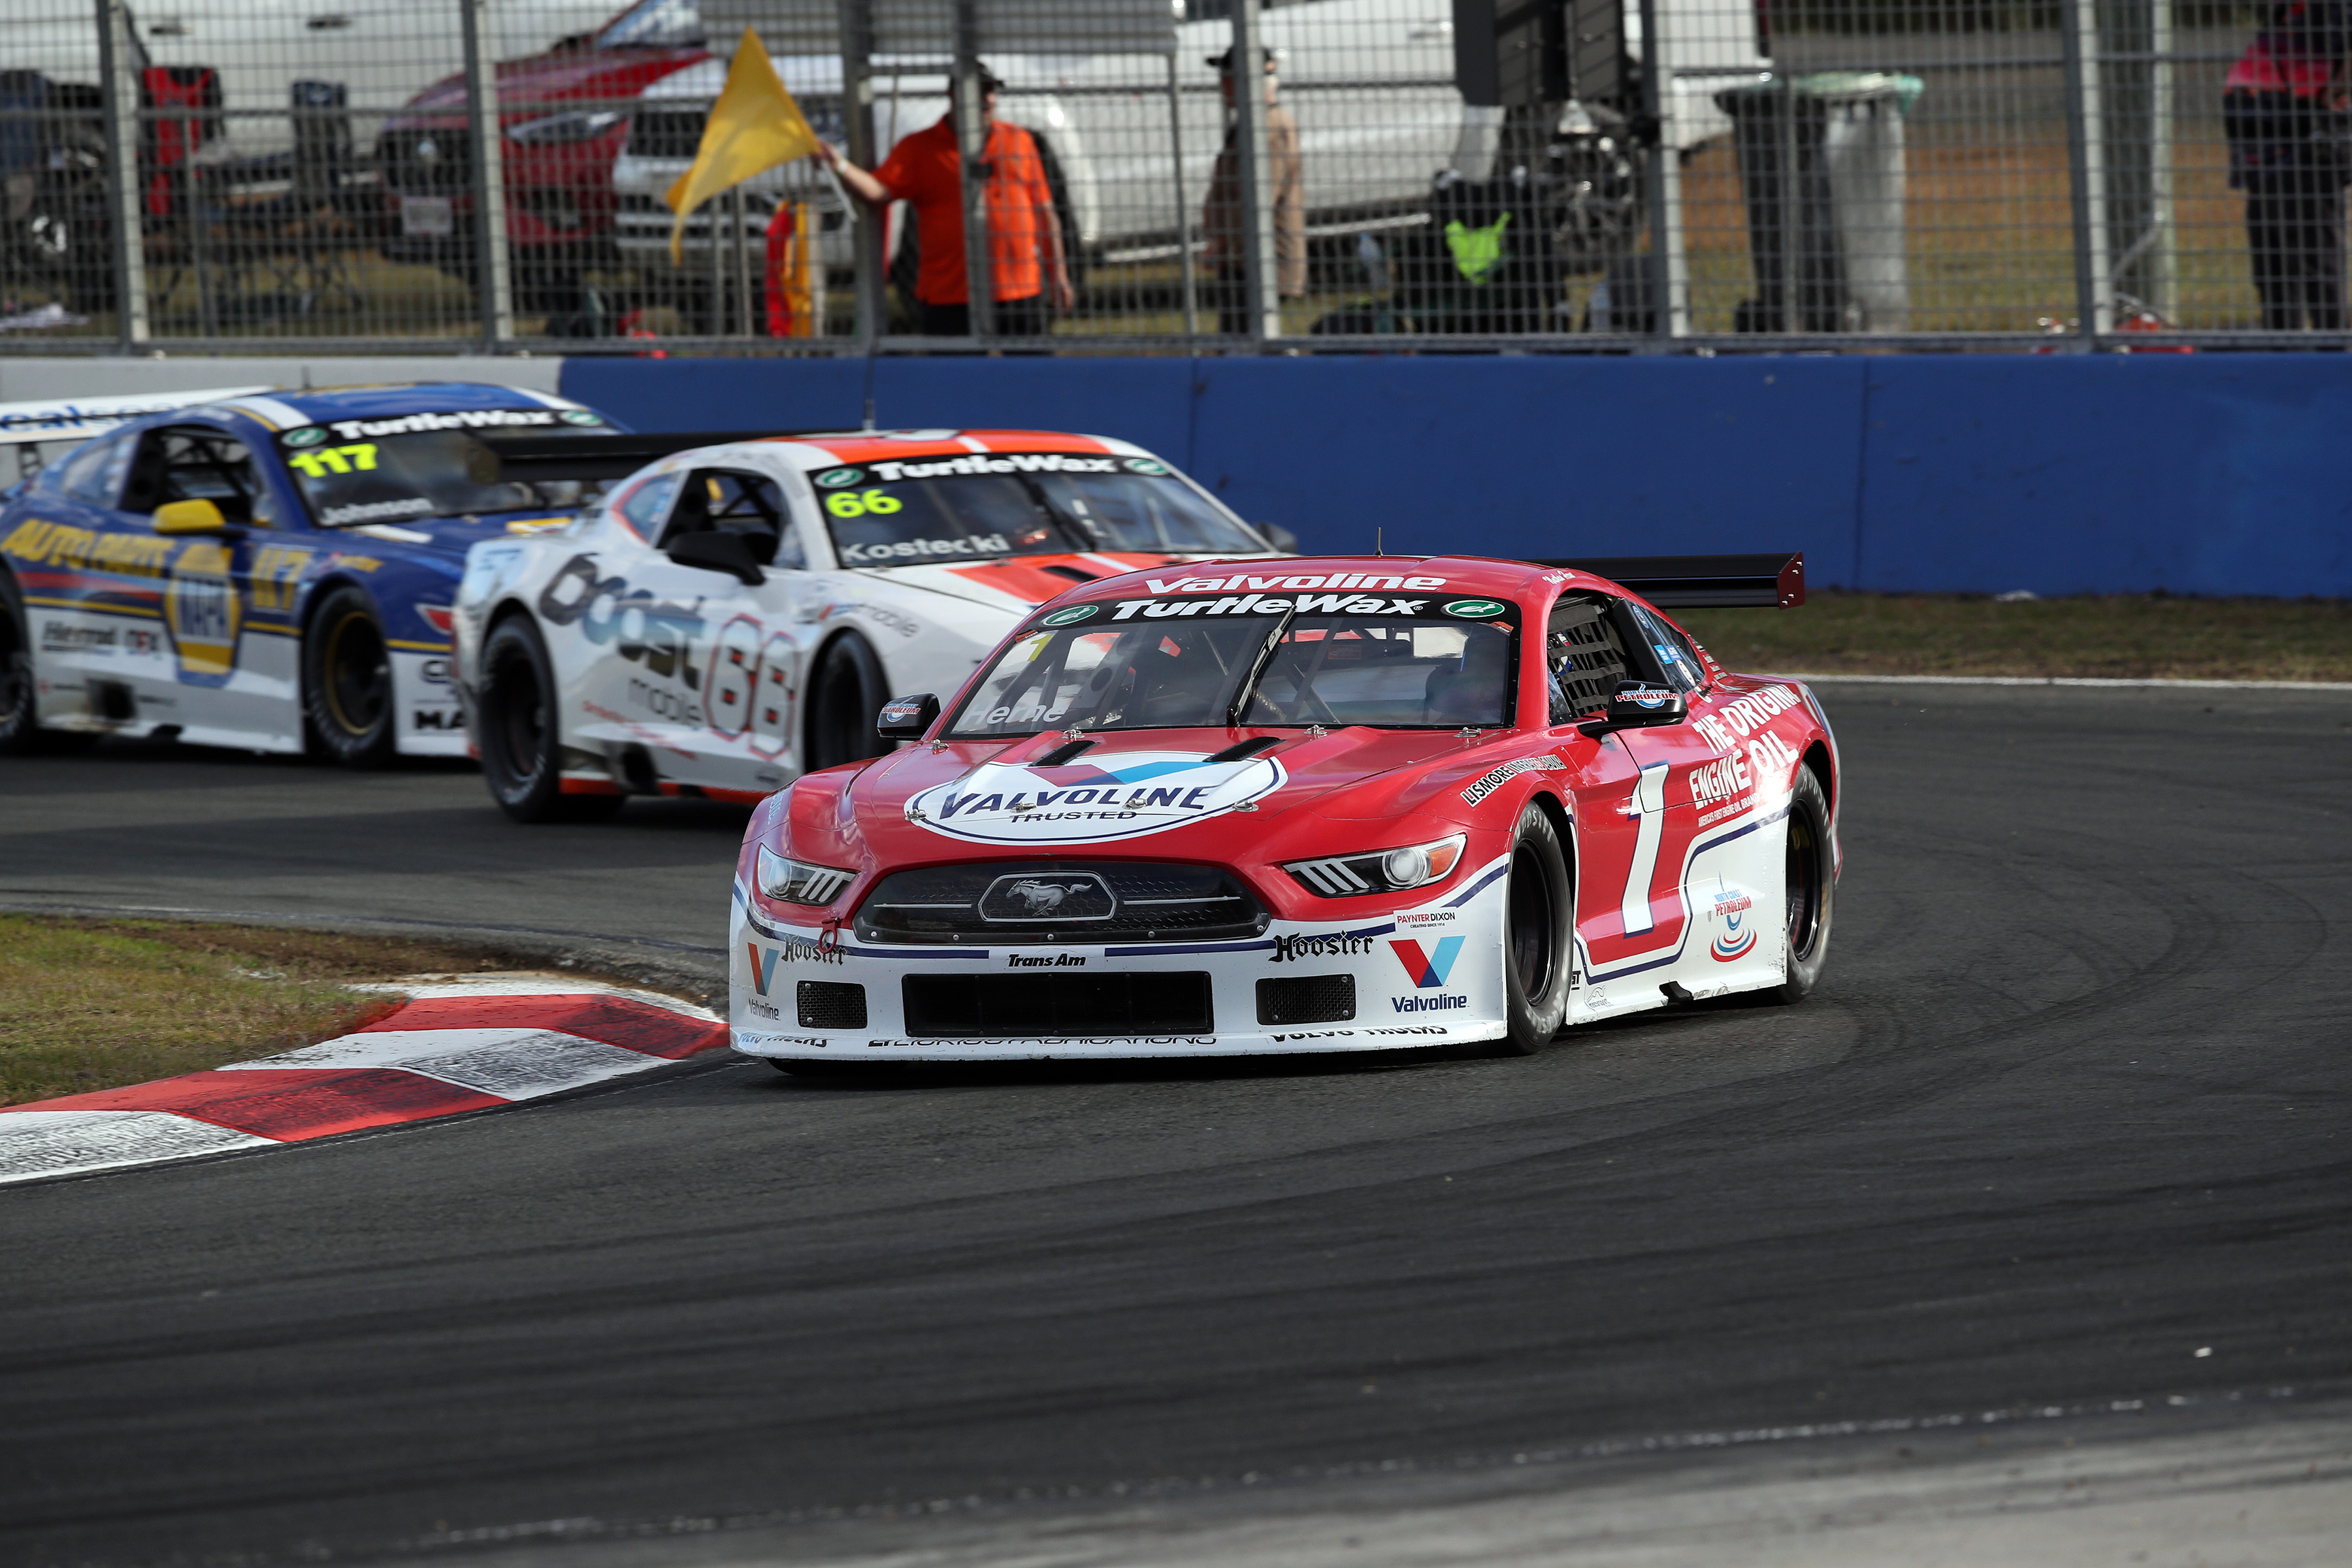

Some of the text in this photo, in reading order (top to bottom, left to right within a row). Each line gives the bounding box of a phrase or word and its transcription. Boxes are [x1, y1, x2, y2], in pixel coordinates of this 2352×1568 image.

[289, 442, 378, 478] 117
[870, 454, 1118, 482] TurtleWax
[825, 487, 903, 518] 66
[840, 532, 1011, 563] Kostecki
[1145, 573, 1447, 594] Valvoline
[1111, 594, 1431, 620] TurtleWax
[1027, 633, 1054, 661] 1
[1615, 693, 1679, 702] PETROLEUM
[958, 702, 1068, 727] Herne
[1691, 714, 1737, 755] THE
[1689, 730, 1800, 810] ENGINE OIL
[1460, 766, 1518, 808] LISMORE
[939, 786, 1212, 821] VALVOLINE
[1009, 811, 1137, 823] TRUSTED
[1621, 760, 1669, 939] 1
[1397, 912, 1456, 924] PAYNTER DIXON
[1714, 896, 1752, 917] PETROLEUM
[1267, 930, 1374, 962] Hoosier
[1008, 954, 1086, 967] Trans Am
[748, 998, 780, 1021] Valvoline
[1391, 994, 1468, 1013] Valvoline
